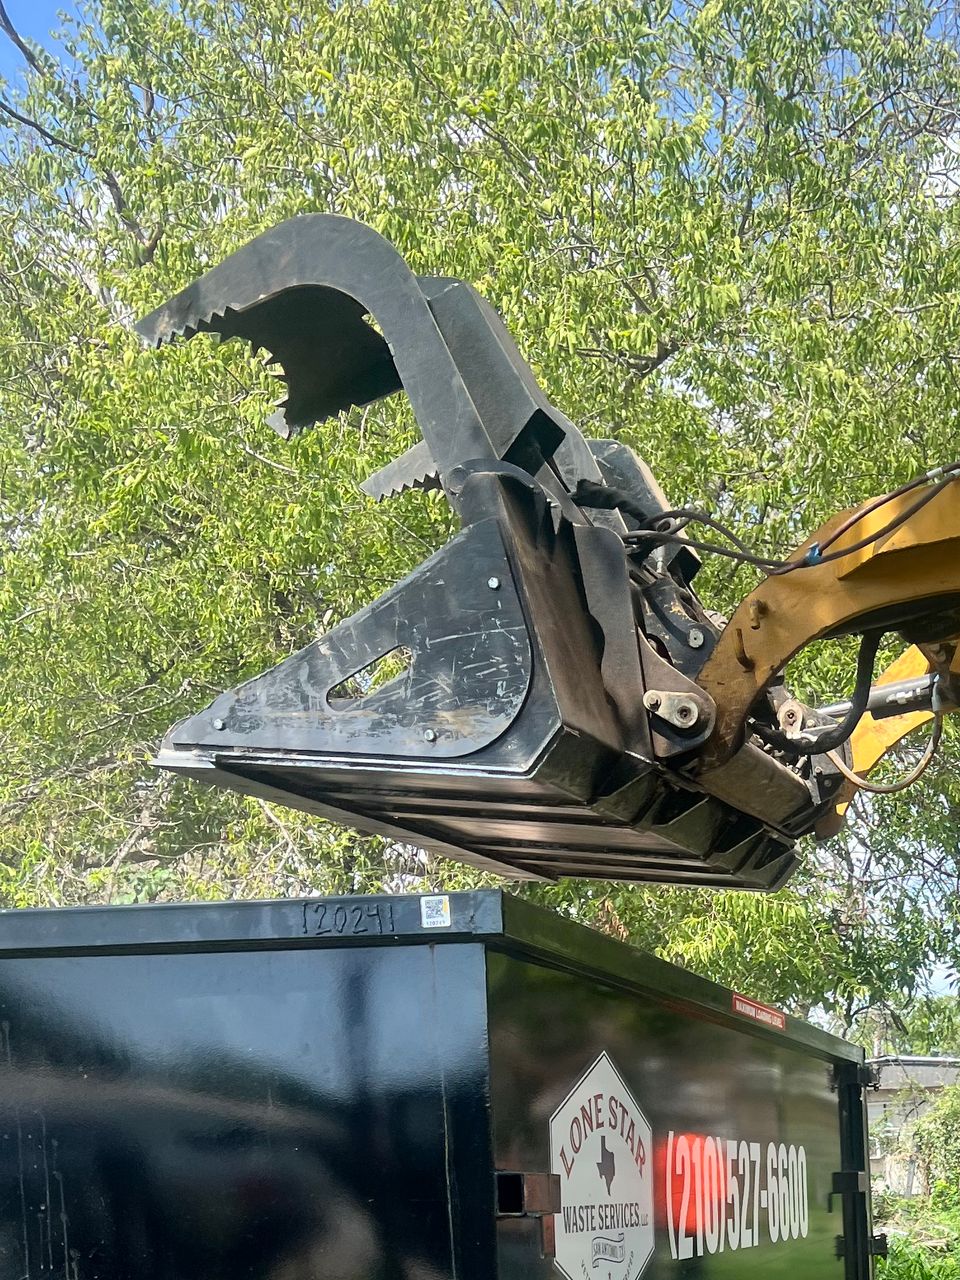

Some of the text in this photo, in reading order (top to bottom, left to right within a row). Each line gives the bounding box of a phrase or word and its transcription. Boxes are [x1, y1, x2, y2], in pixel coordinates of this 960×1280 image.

[302, 902, 395, 935] 120241
[560, 1093, 646, 1180] LONE STAR
[562, 1205, 596, 1234] WASTE
[666, 1130, 809, 1260] (210)527-6600
